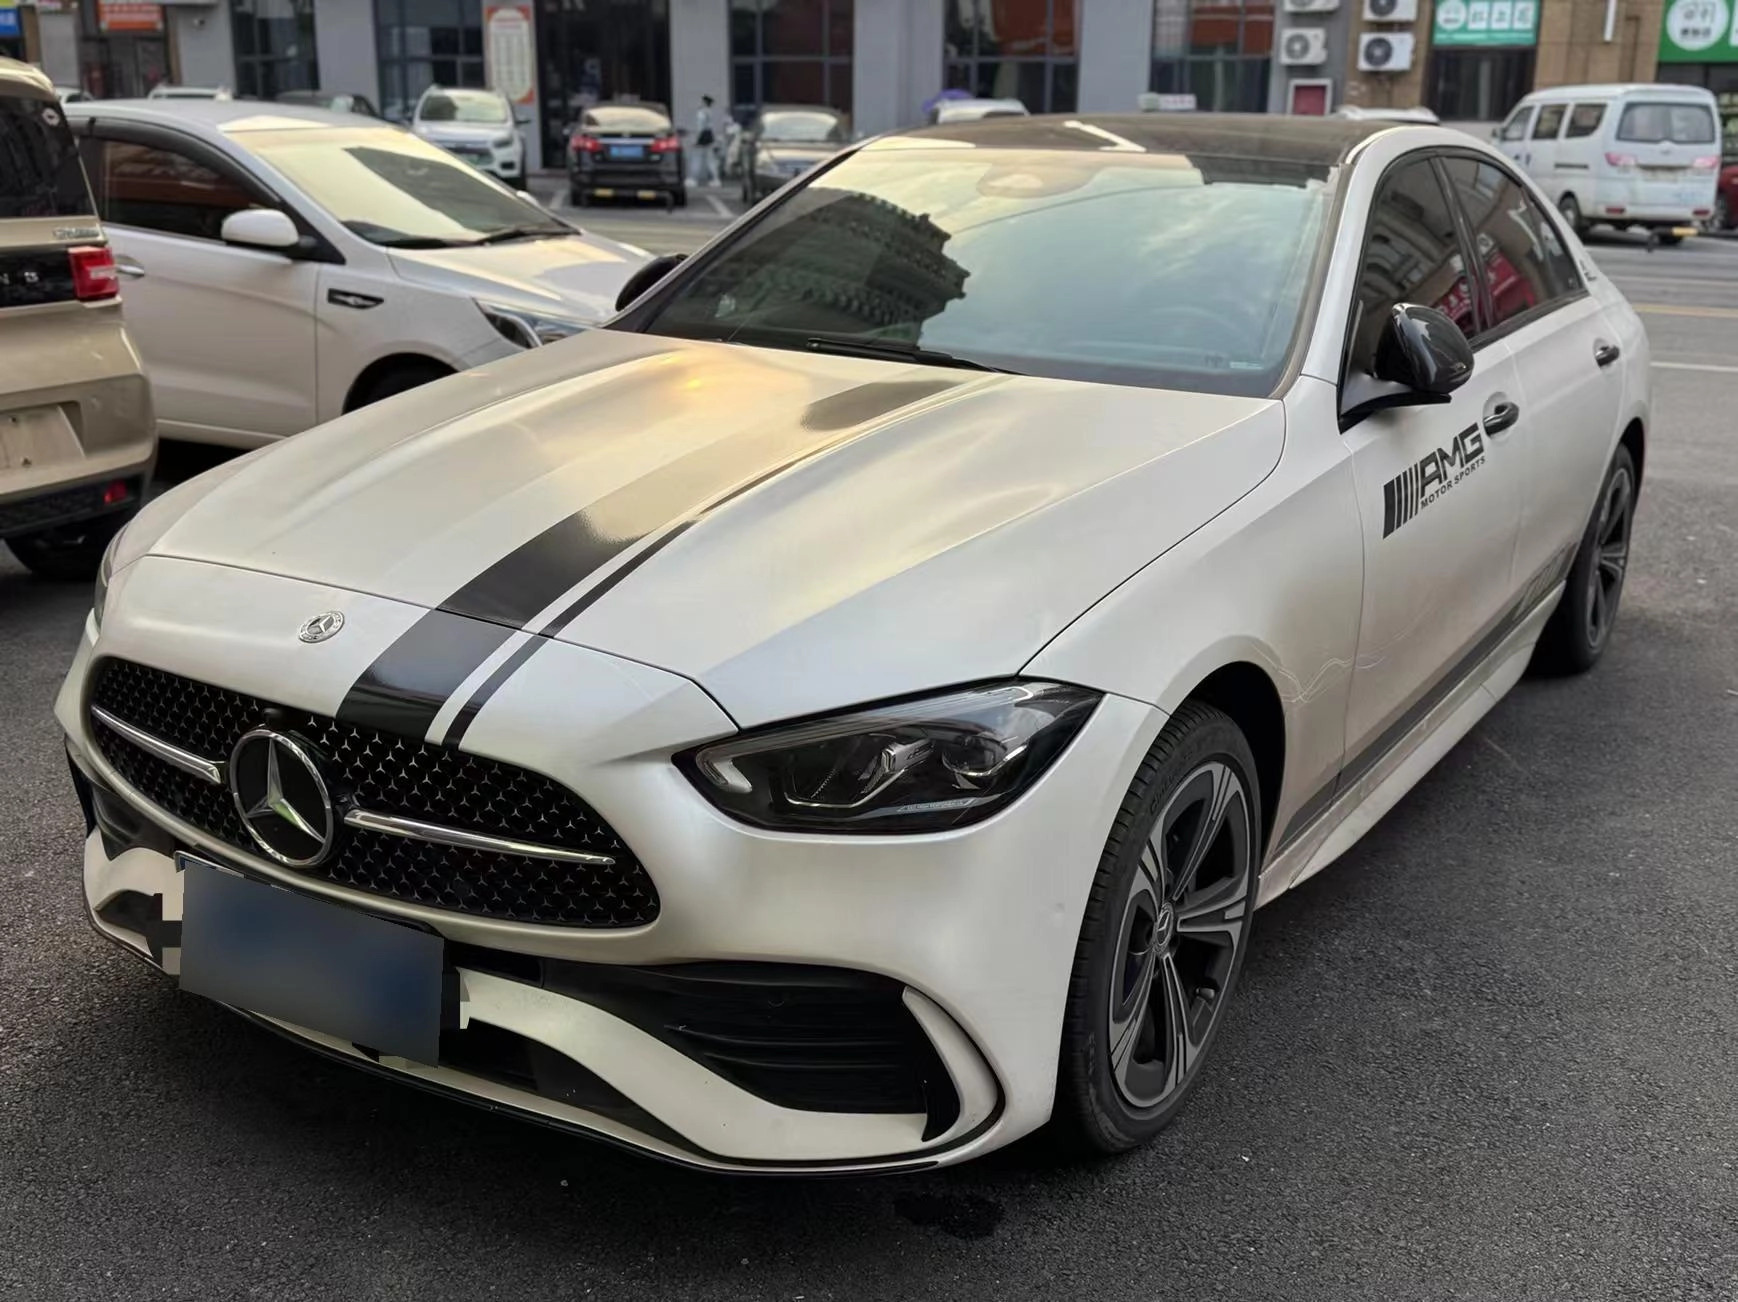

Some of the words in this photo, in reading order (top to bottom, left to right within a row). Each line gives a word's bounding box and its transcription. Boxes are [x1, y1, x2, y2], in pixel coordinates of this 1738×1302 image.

[1419, 422, 1484, 499] AMG
[1420, 480, 1453, 510] MOTOR
[1454, 455, 1486, 484] SPORTS
